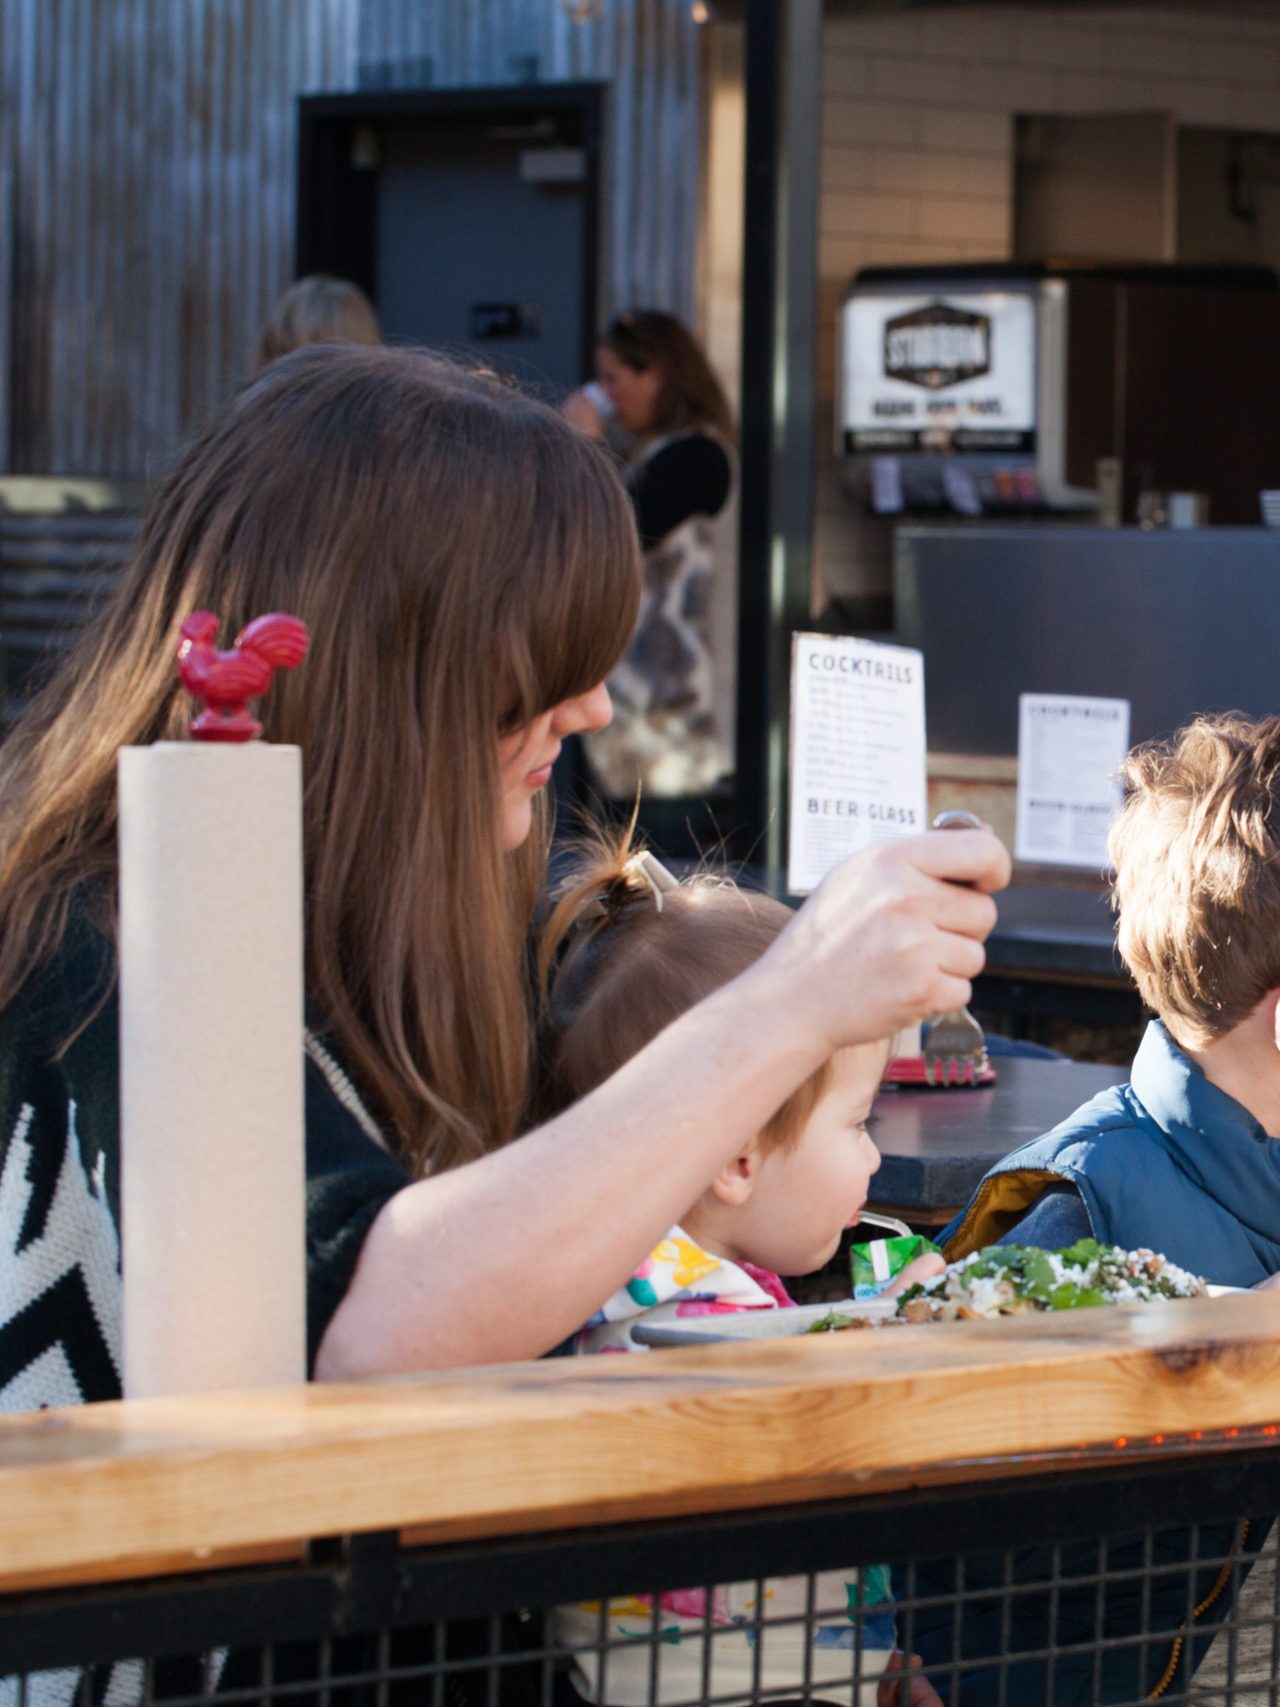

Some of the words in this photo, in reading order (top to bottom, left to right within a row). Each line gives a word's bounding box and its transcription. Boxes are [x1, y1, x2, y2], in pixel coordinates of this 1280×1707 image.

[808, 653, 912, 684] COCKTAILS
[807, 798, 858, 817] BEER
[868, 803, 915, 825] GLASS
